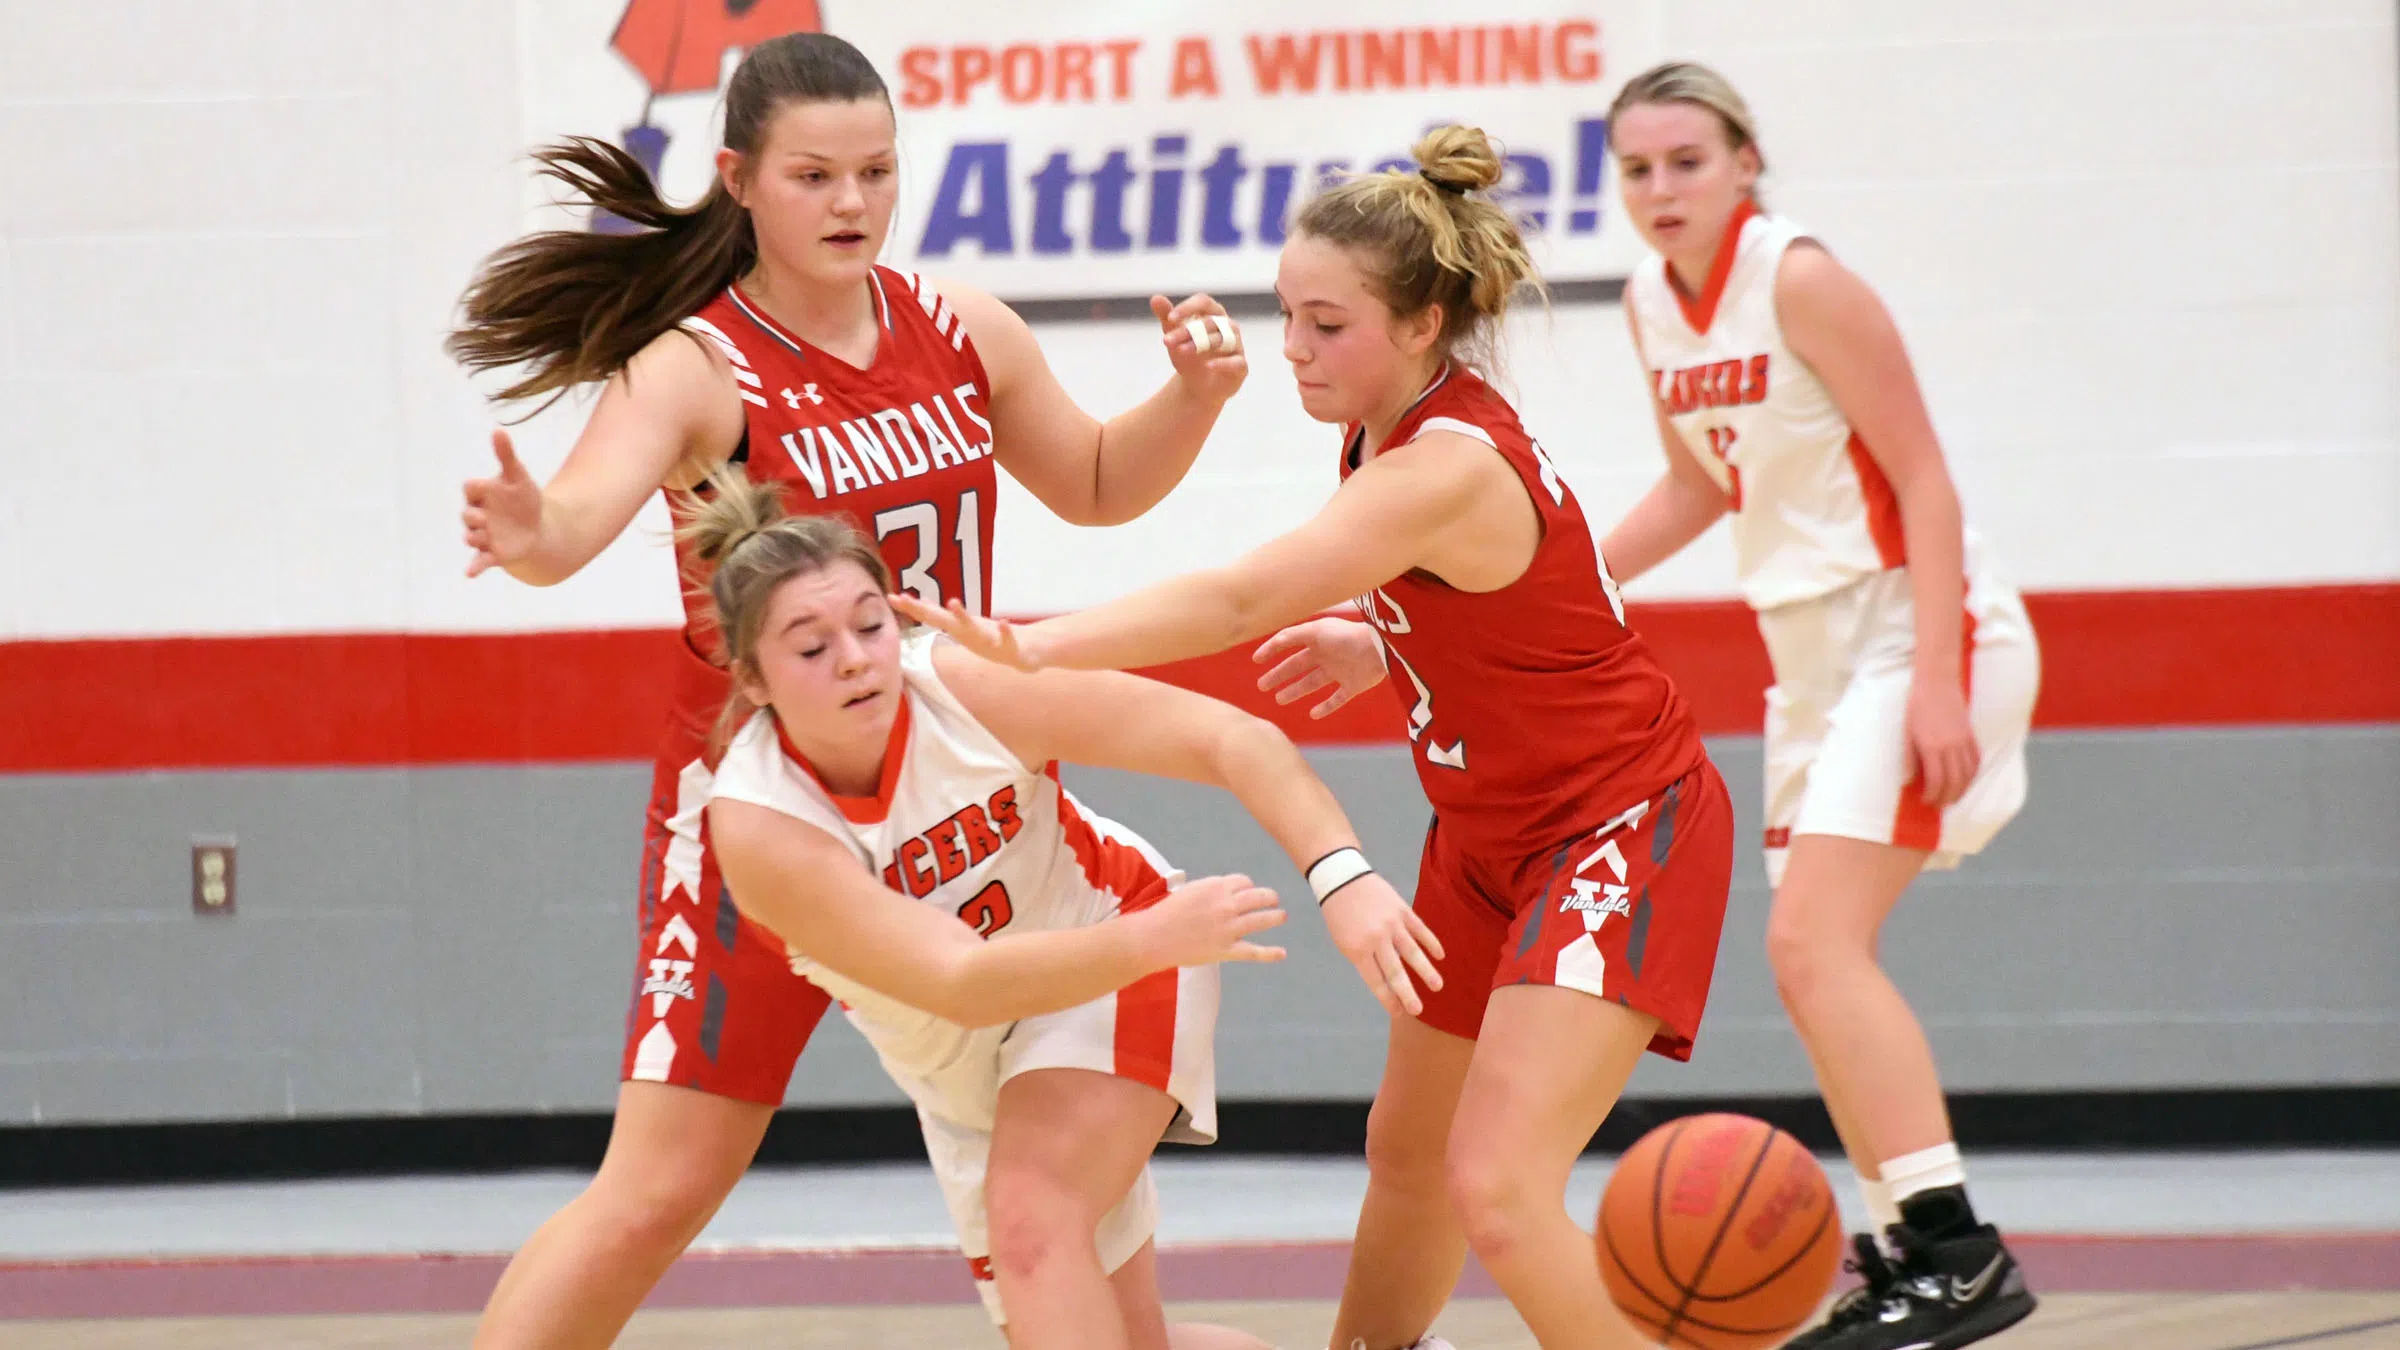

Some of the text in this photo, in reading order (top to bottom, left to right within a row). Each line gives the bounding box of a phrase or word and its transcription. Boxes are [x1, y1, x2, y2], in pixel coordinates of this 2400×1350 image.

[899, 40, 1141, 109] SPORT
[1168, 37, 1221, 98] A
[1244, 20, 1601, 94] WINNING
[779, 381, 994, 500] VANDALS
[873, 487, 984, 622] 31
[1559, 894, 1630, 918] Vandals
